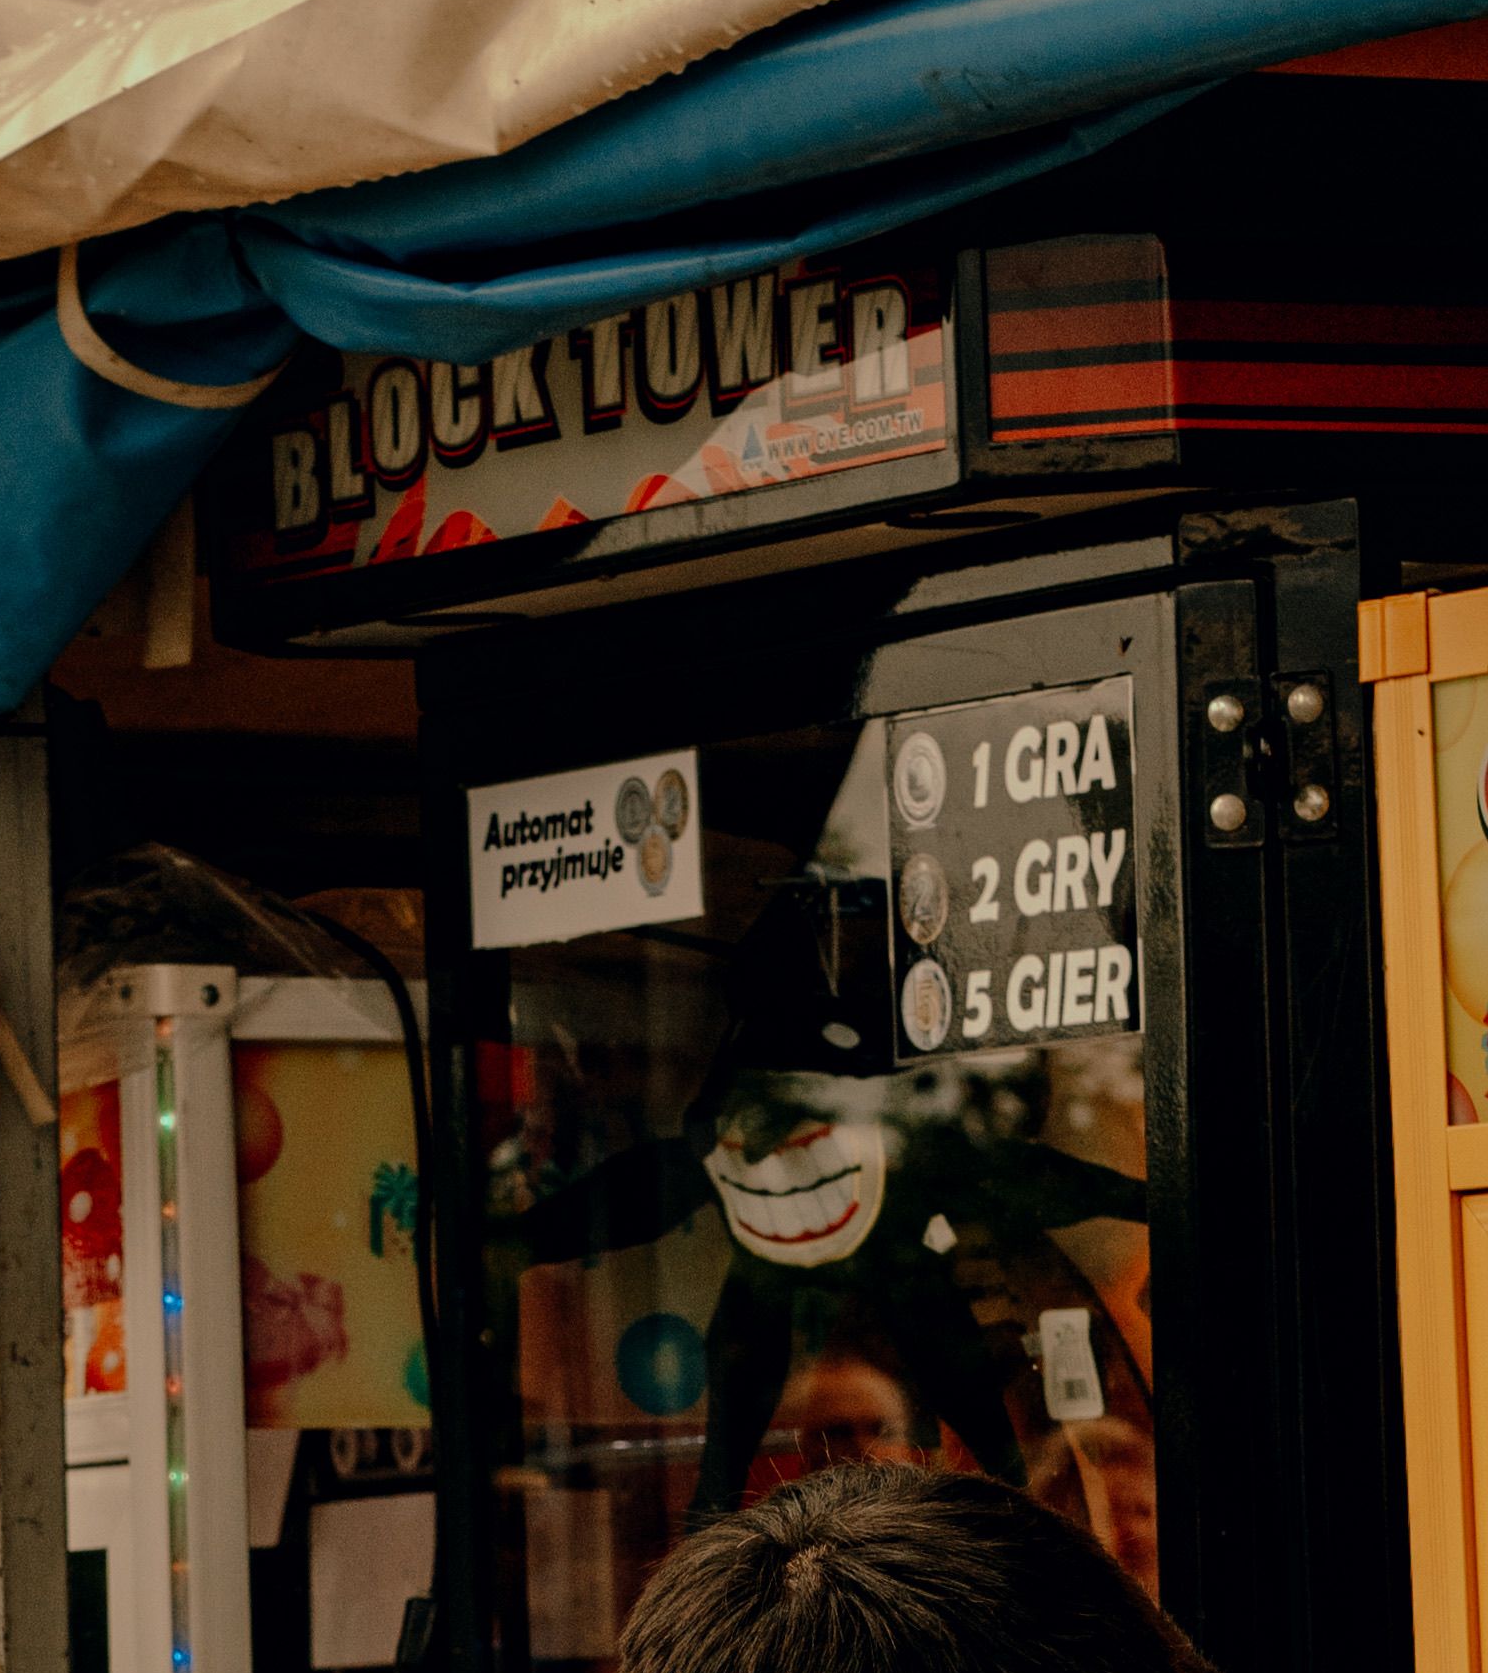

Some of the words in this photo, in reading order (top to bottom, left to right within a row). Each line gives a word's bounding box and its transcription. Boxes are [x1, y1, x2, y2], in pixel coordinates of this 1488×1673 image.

[270, 337, 555, 533] BLOCK
[579, 272, 911, 415] TOWER
[972, 739, 992, 810] 1
[1004, 714, 1118, 805] GRA
[482, 799, 595, 853] Automat
[499, 839, 626, 898] przyjmuje
[968, 858, 1000, 924] 2
[1010, 828, 1127, 920] GRY
[962, 966, 994, 1039] 5
[1004, 944, 1133, 1034] GIER
